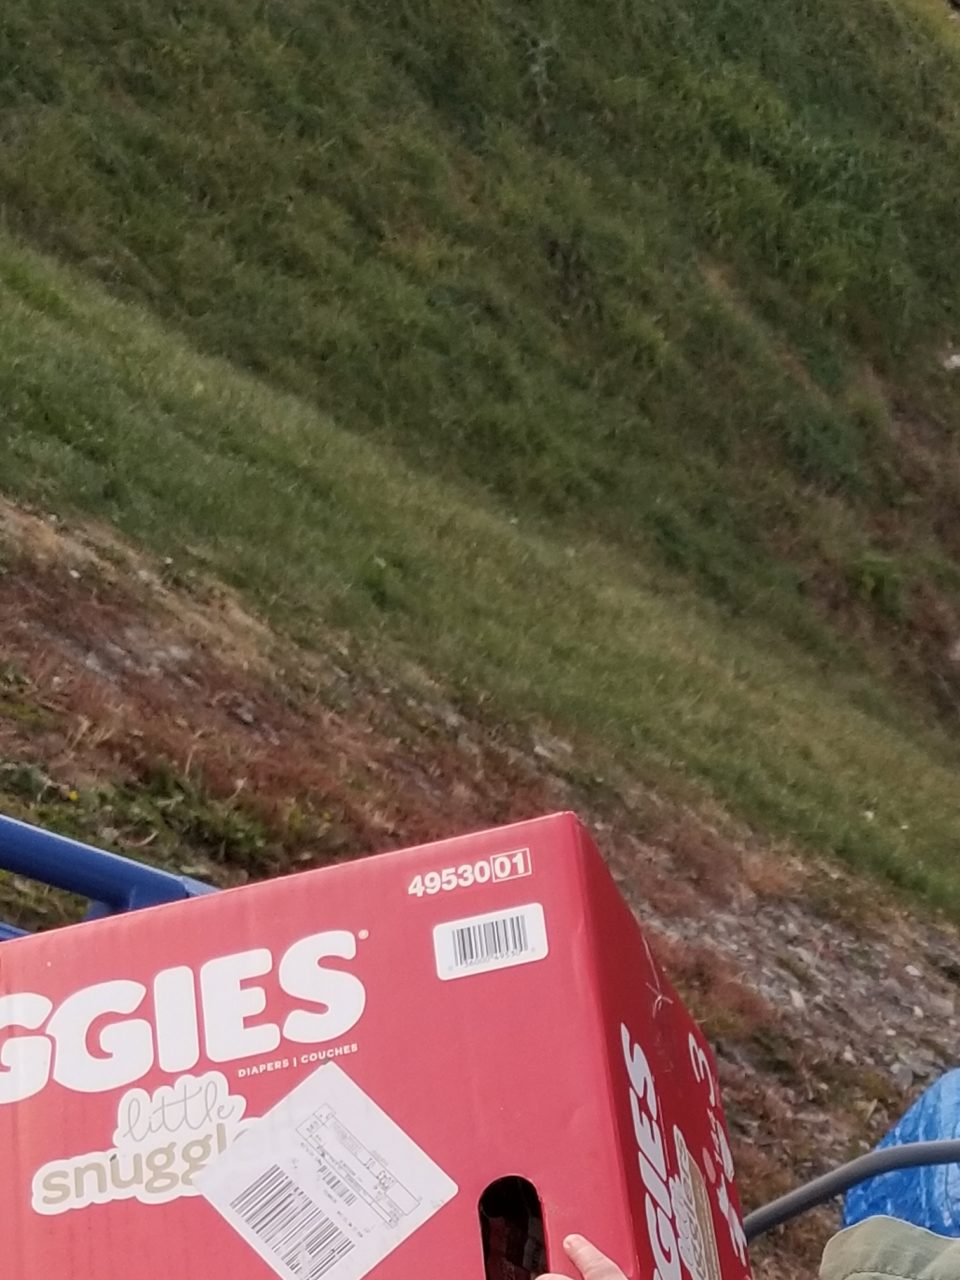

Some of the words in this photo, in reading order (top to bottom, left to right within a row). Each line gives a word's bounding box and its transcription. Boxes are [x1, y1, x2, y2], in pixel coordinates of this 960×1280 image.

[237, 1058, 290, 1078] DIAPERS
[300, 1043, 359, 1065] COUCHES
[123, 1080, 235, 1142] little
[42, 1122, 248, 1205] snuggl
